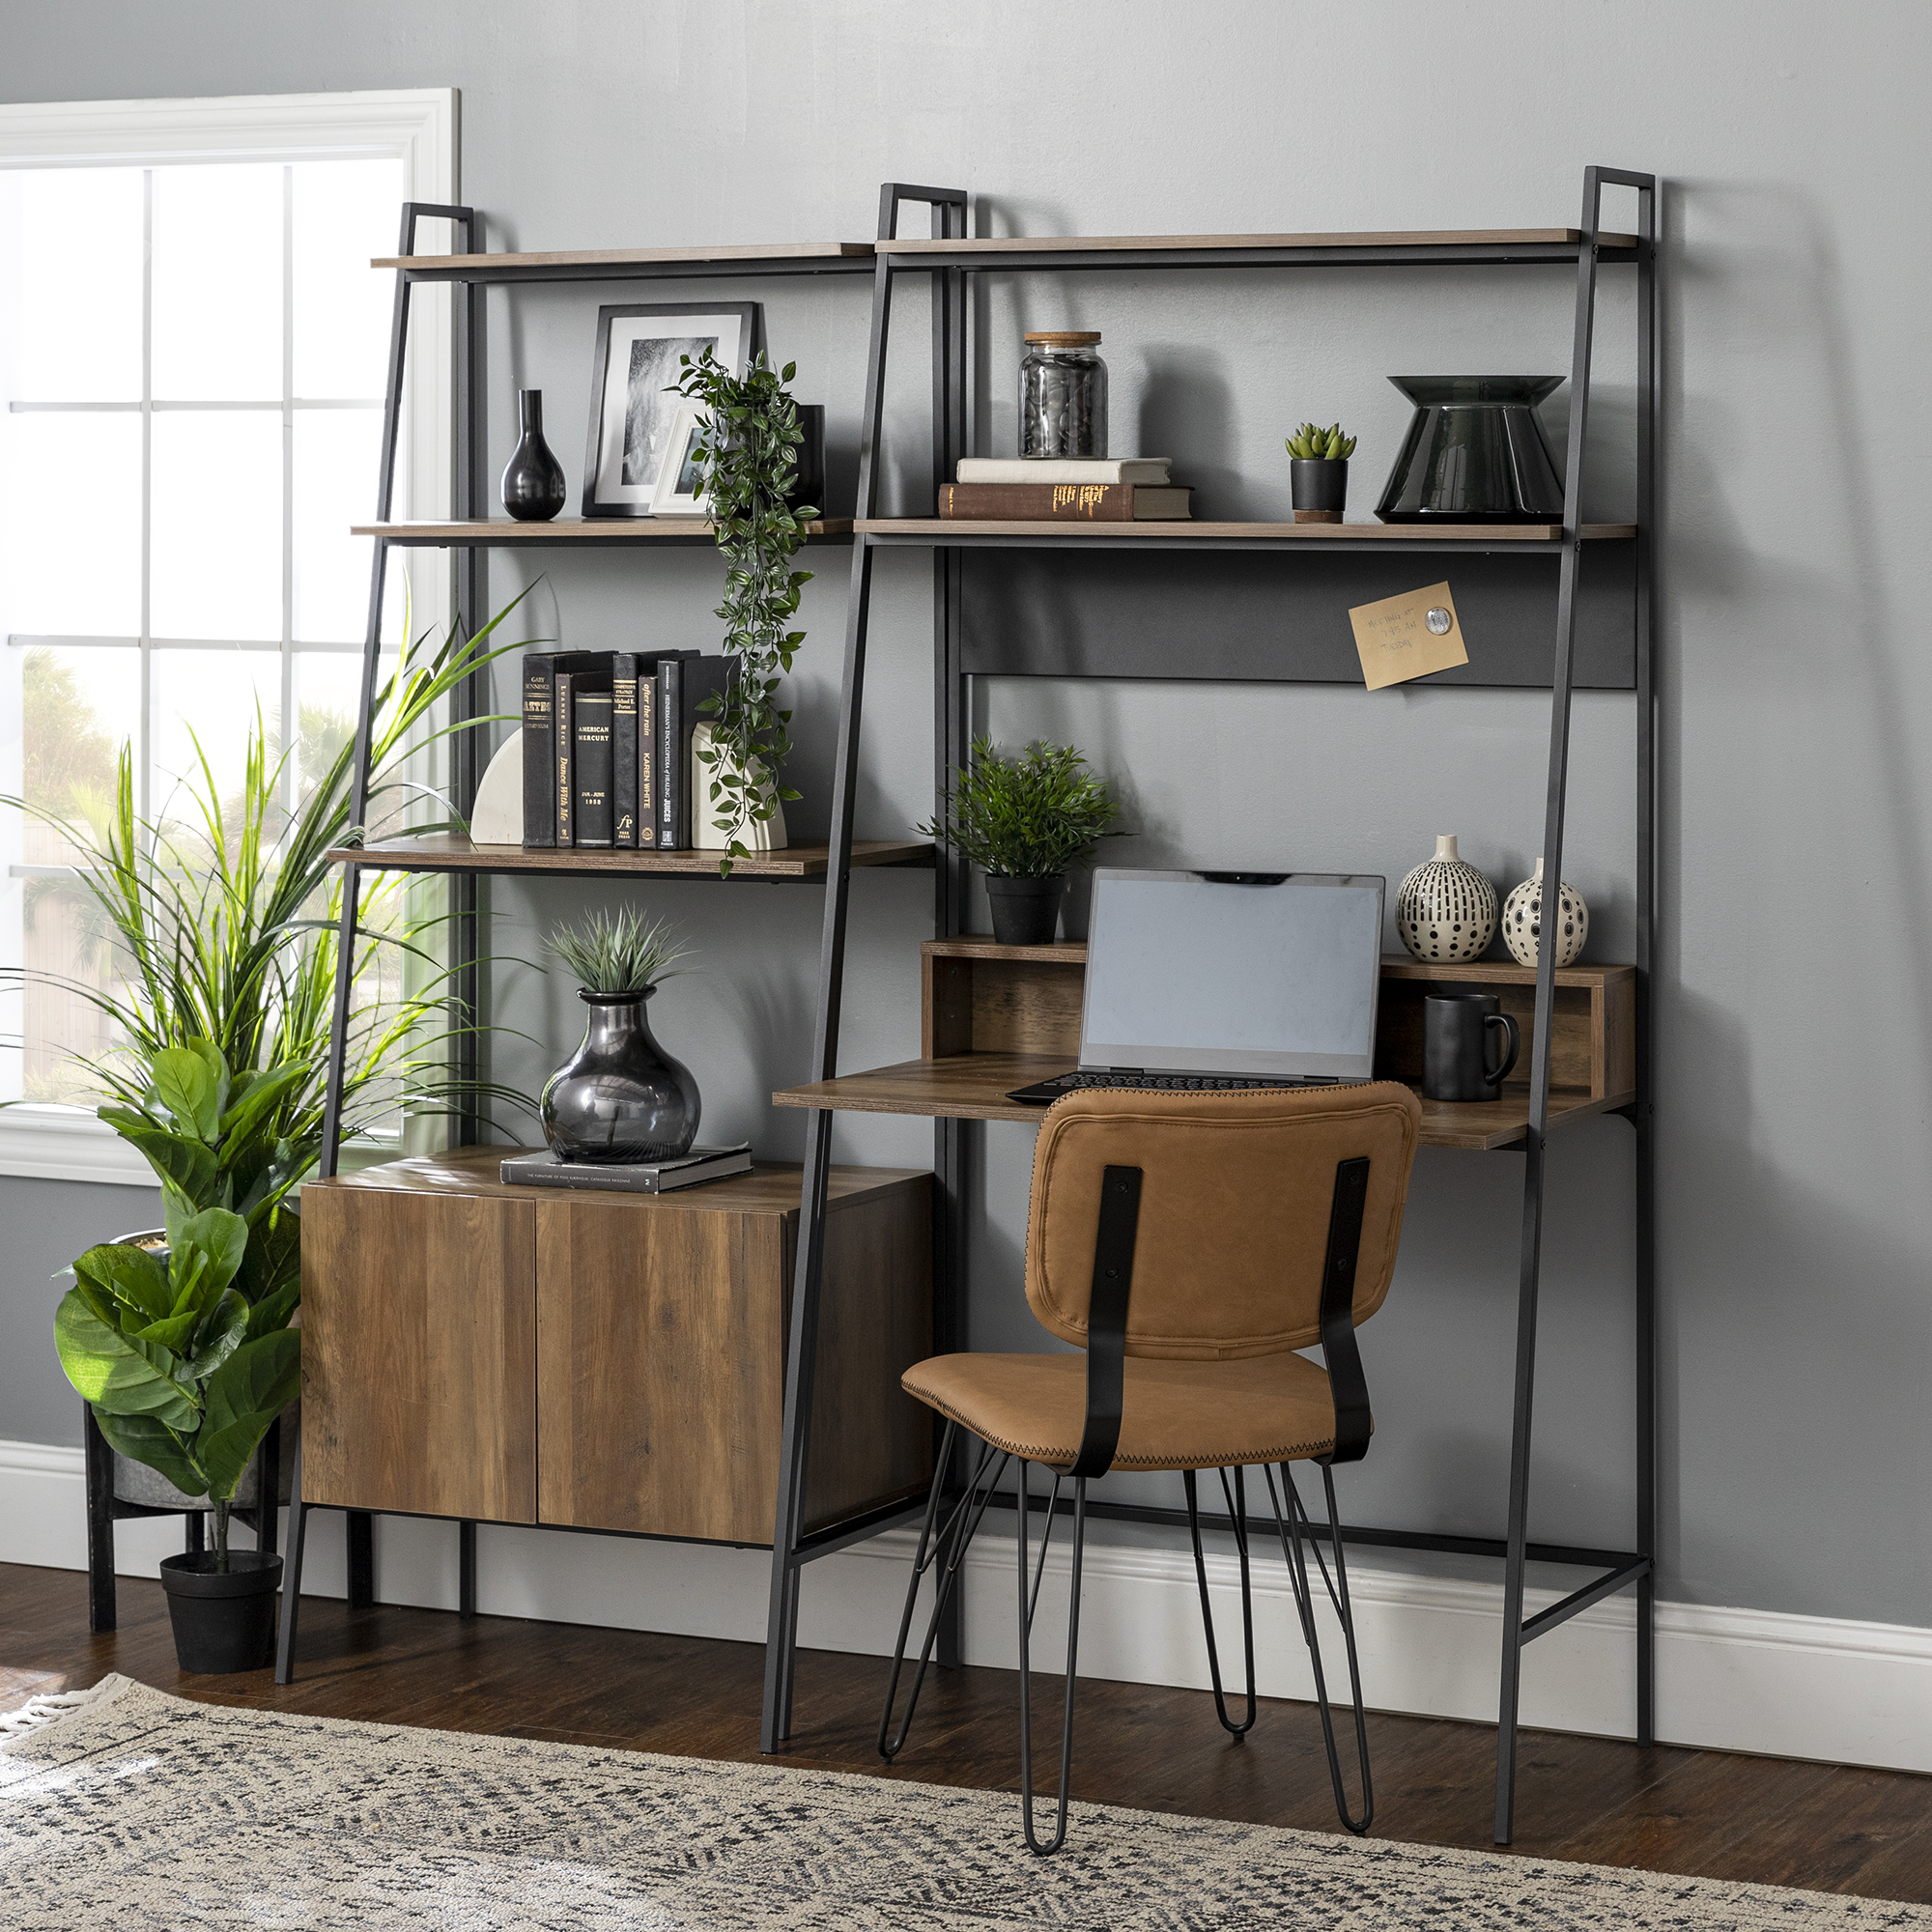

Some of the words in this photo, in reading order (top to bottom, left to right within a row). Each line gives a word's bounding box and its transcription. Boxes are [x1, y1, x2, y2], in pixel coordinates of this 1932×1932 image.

[1368, 612, 1401, 628] MEETING
[1406, 621, 1417, 632] AM
[1380, 639, 1412, 651] TUESDAY
[642, 684, 651, 703] after
[560, 808, 568, 821] Me
